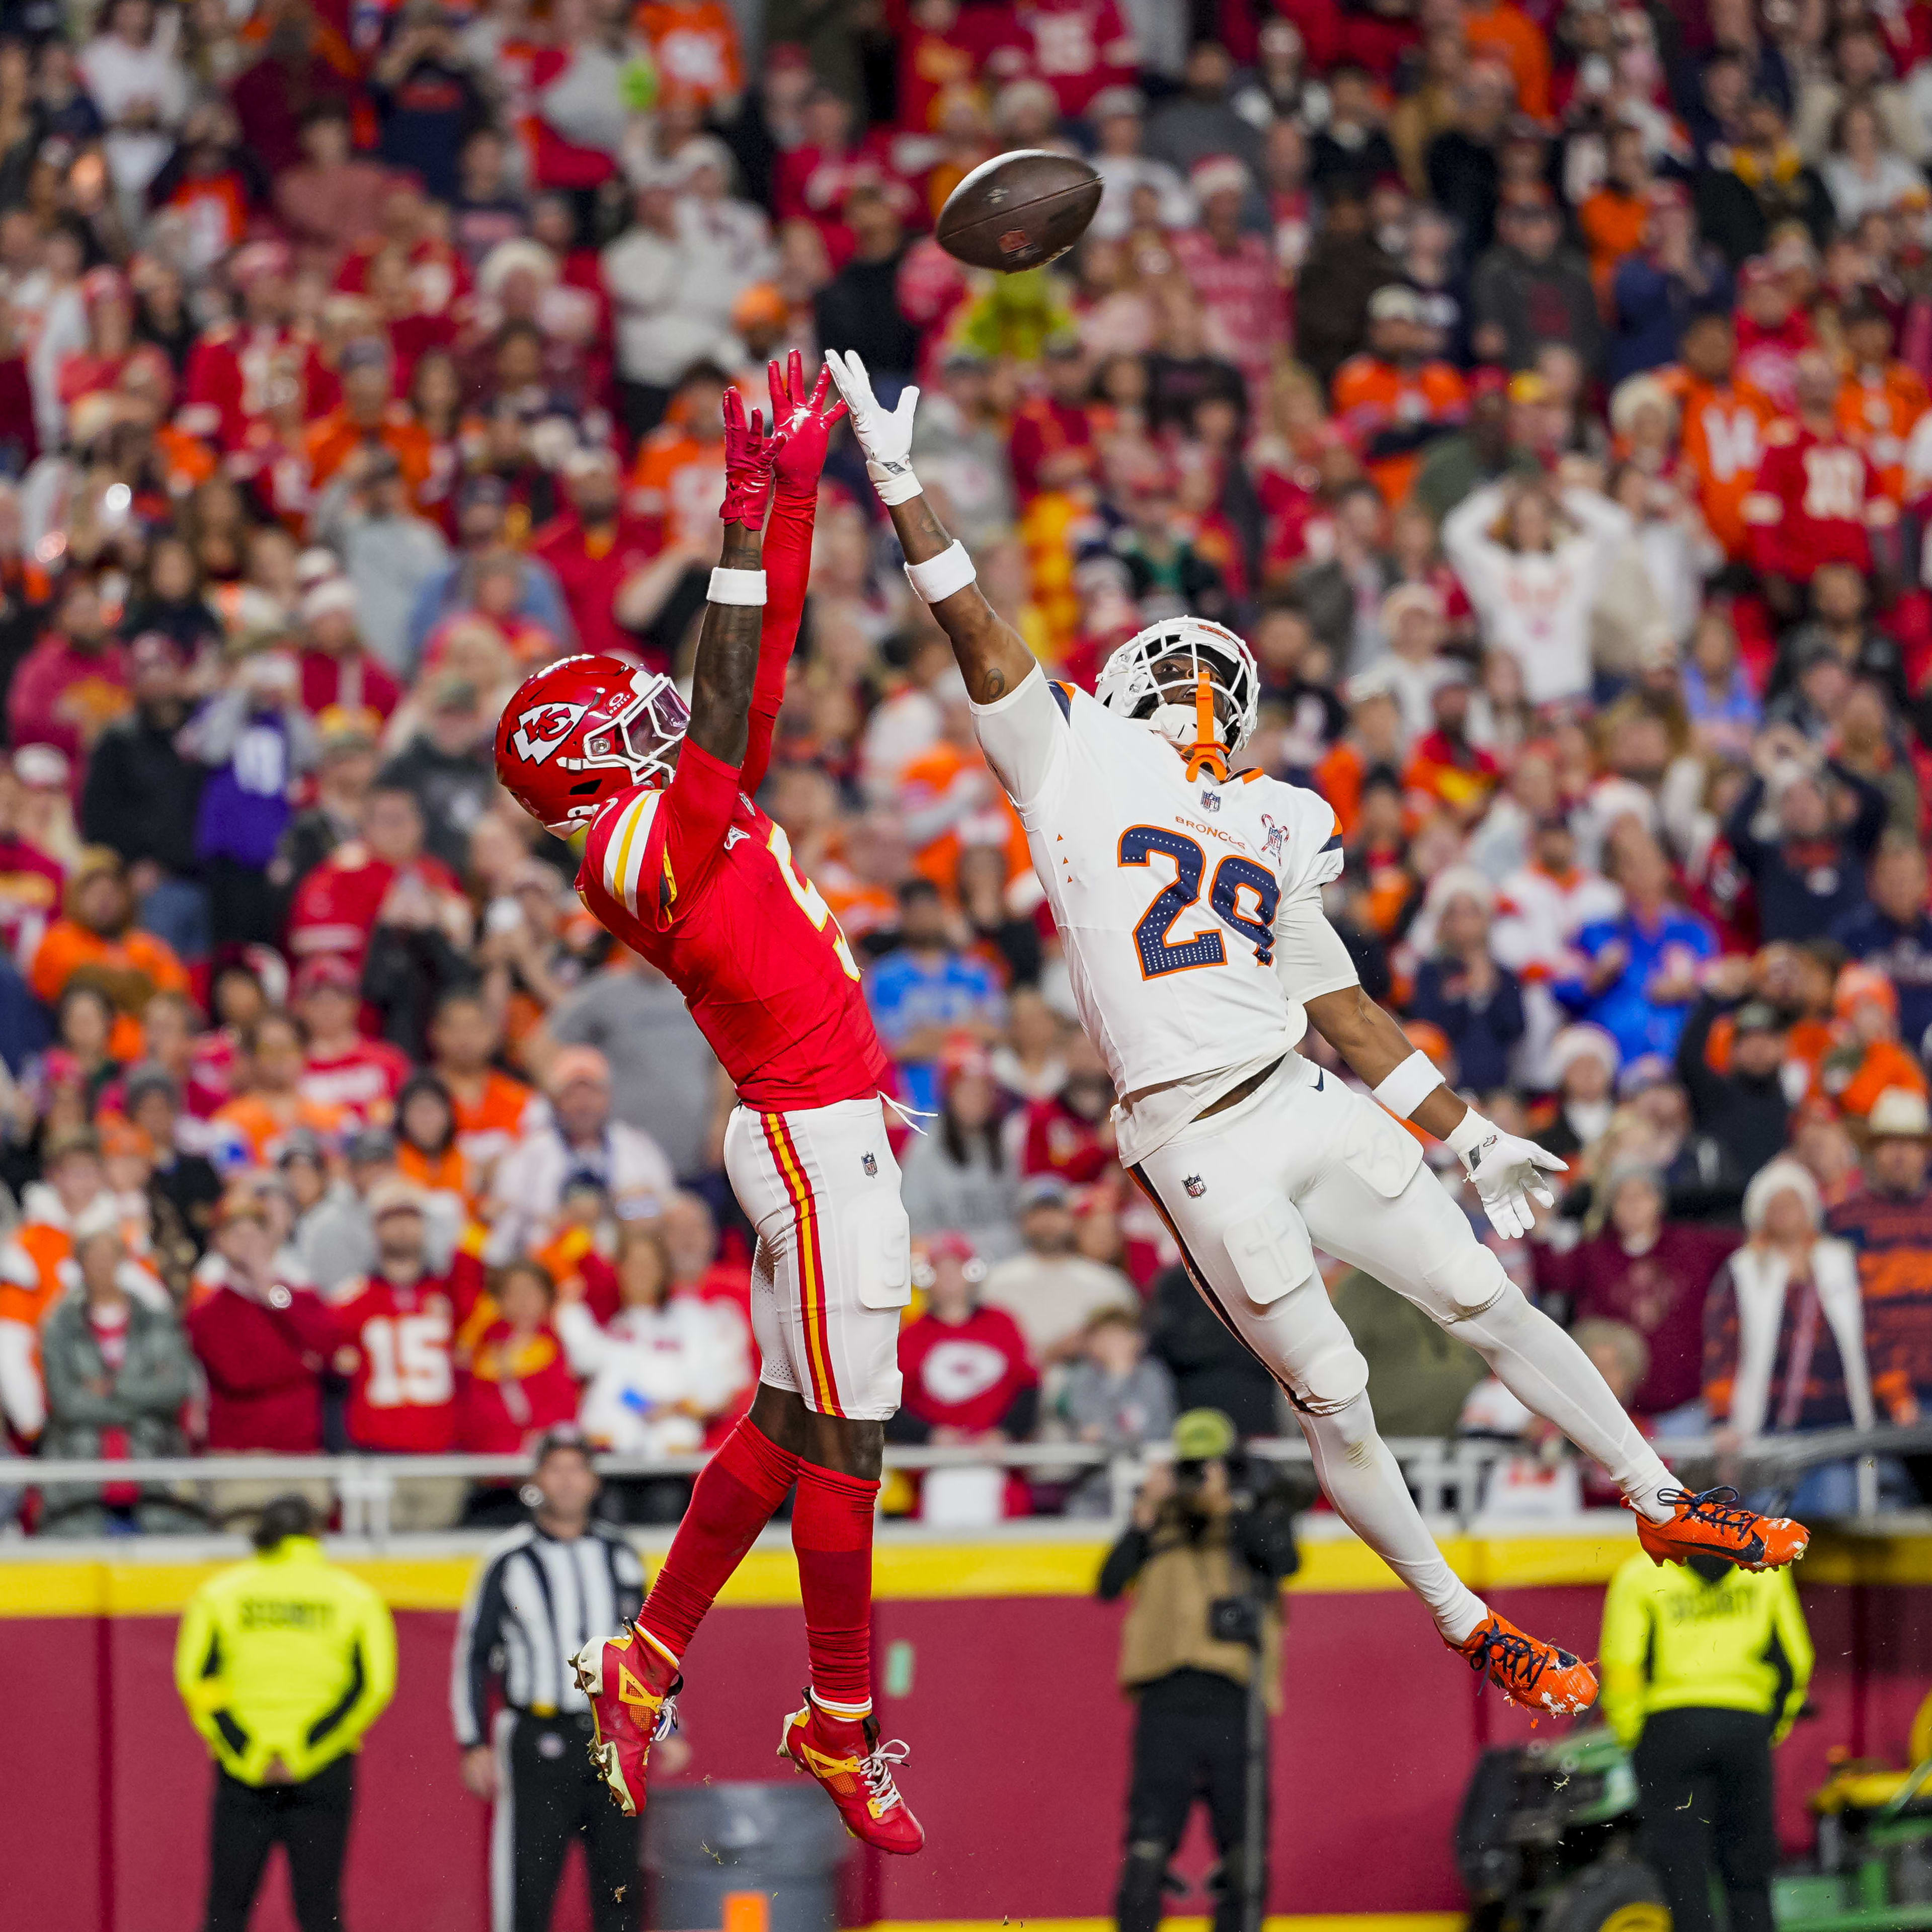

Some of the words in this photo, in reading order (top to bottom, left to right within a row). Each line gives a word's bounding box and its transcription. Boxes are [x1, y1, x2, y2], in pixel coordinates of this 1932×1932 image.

[609, 694, 630, 714] OAKLEY
[523, 706, 574, 745] KC
[1203, 798, 1218, 810] NFL
[1268, 835, 1280, 849] NFL
[1117, 824, 1281, 981] 29
[1187, 1183, 1204, 1196] NFL
[360, 1315, 455, 1407] 15
[239, 1598, 337, 1631] SECURITY
